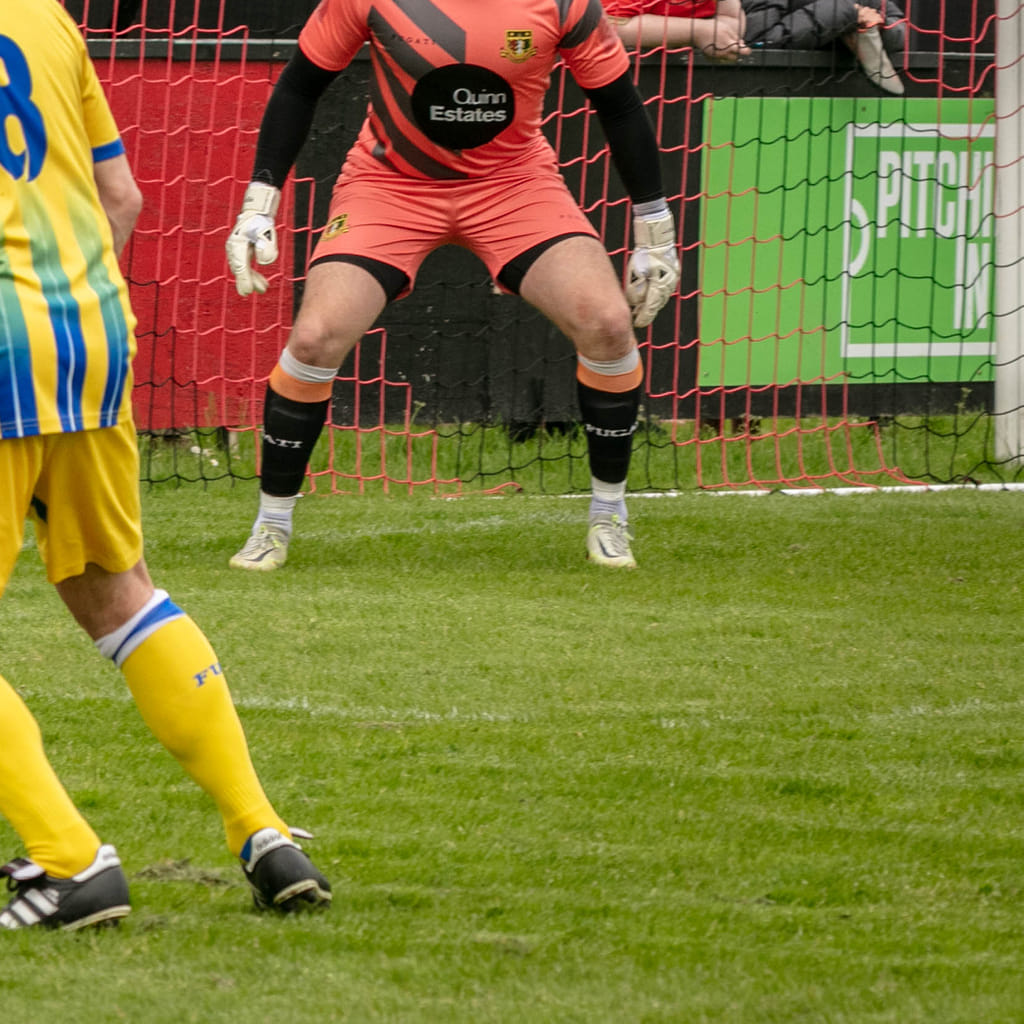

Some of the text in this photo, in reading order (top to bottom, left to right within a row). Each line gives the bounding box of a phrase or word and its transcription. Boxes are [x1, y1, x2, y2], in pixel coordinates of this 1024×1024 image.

[452, 87, 507, 106] Quinn
[429, 105, 508, 123] Estates
[953, 242, 992, 330] IN
